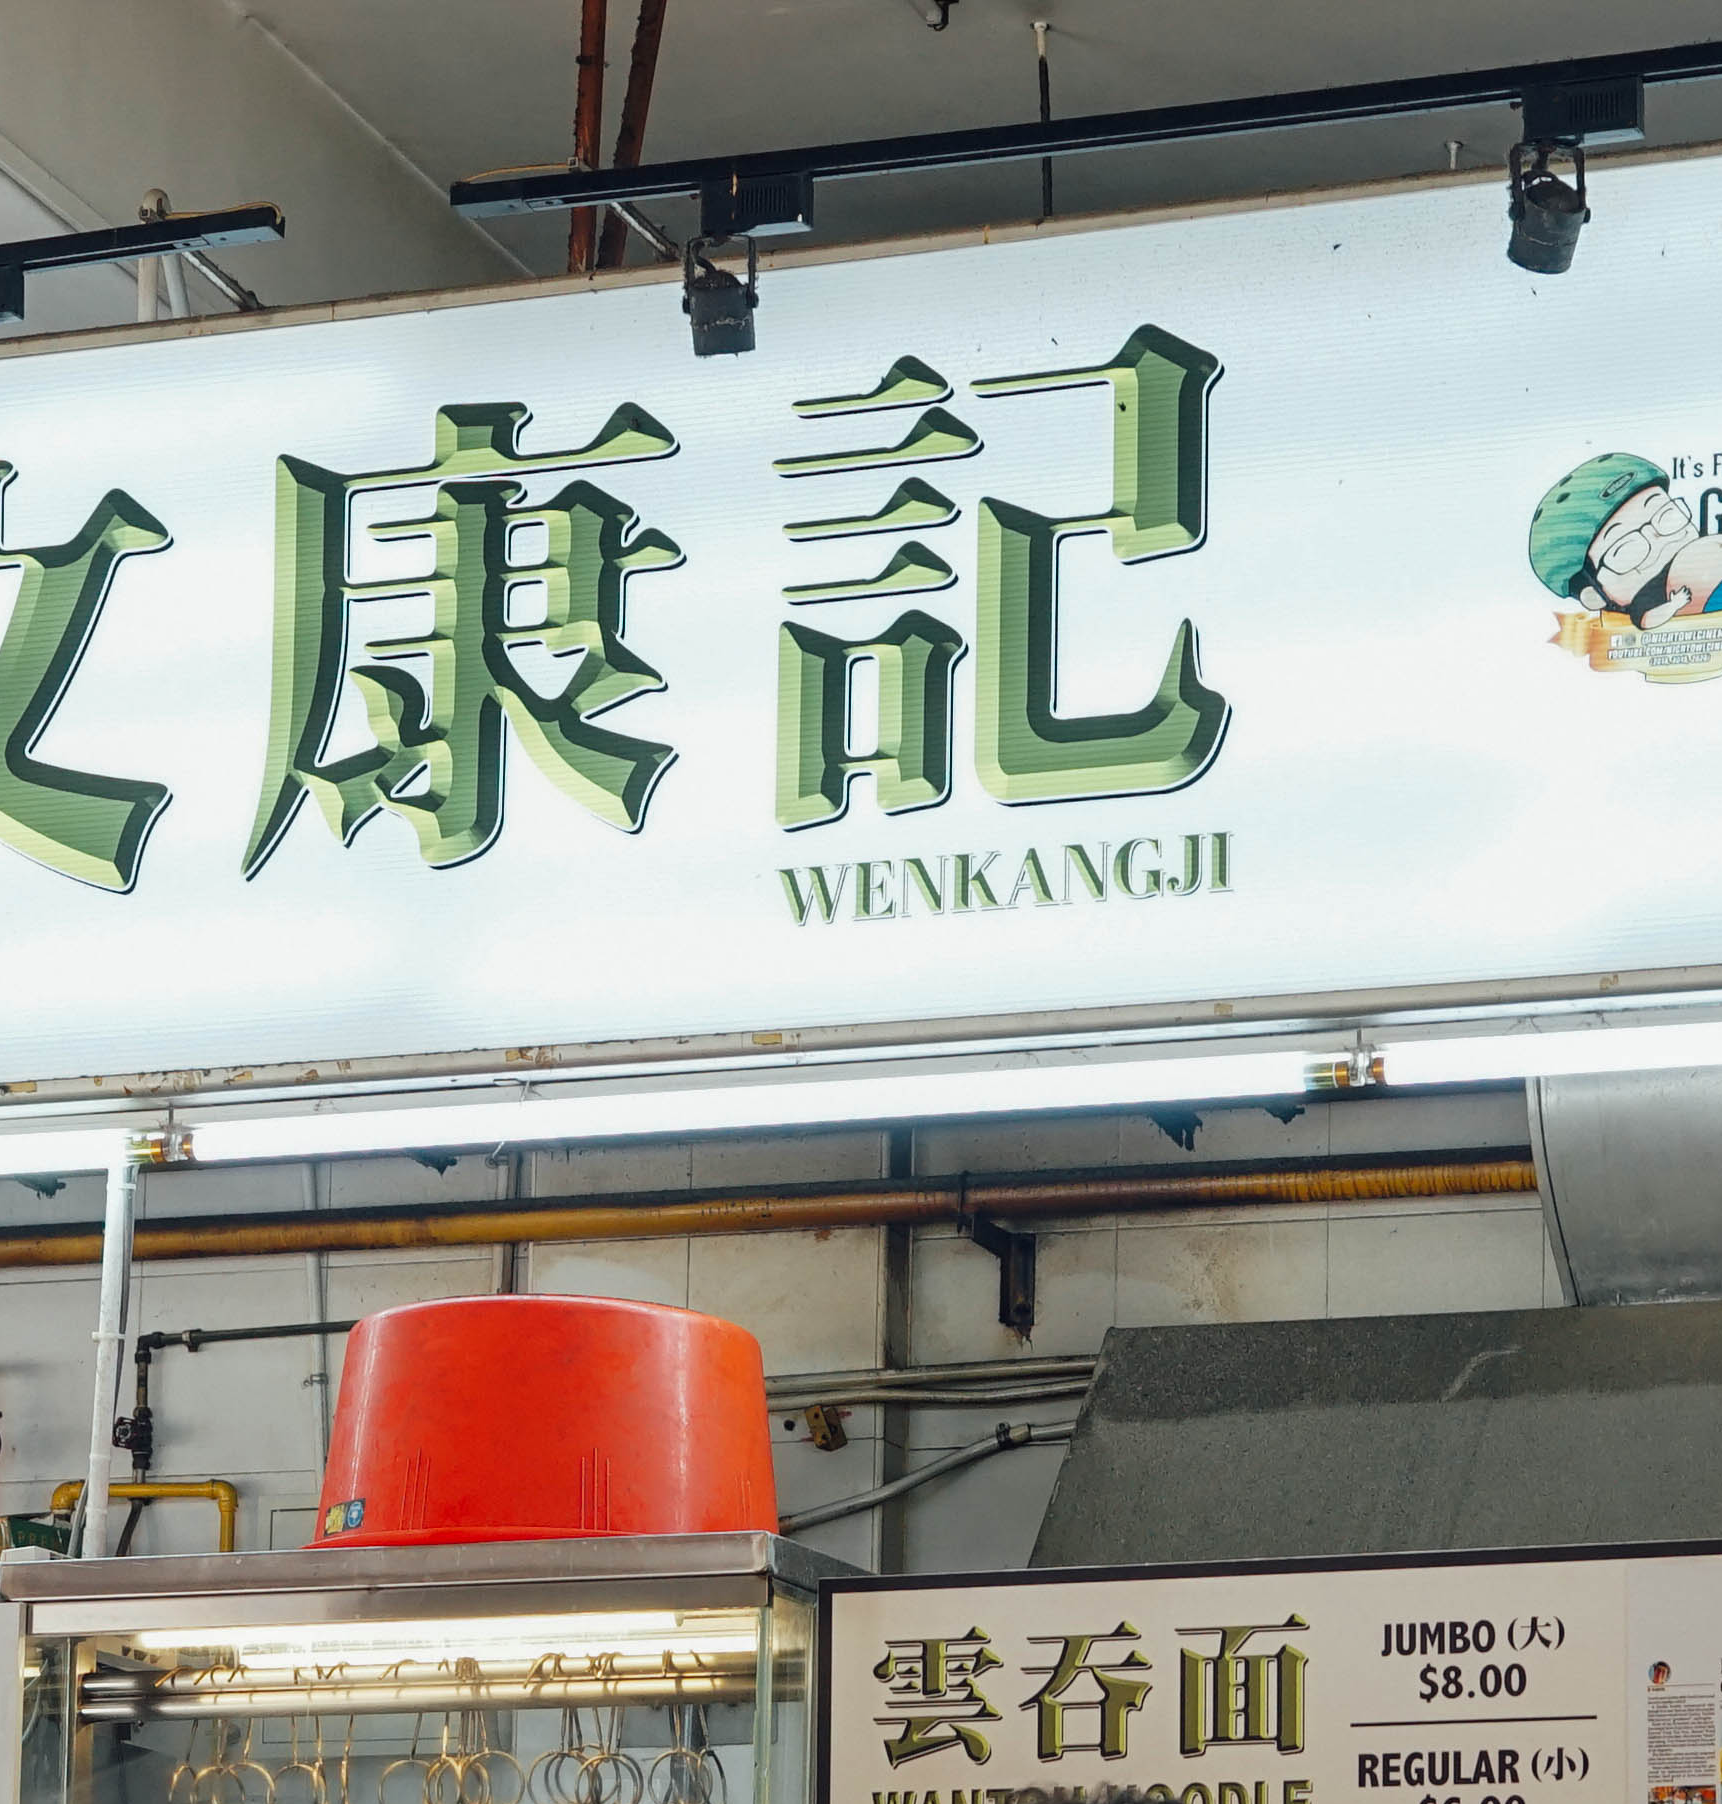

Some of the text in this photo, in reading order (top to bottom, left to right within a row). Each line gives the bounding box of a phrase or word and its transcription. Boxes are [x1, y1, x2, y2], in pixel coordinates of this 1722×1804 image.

[1672, 456, 1703, 480] It's
[779, 831, 1235, 926] WENKANGJI
[1381, 1620, 1496, 1659] JUMBO
[1418, 1662, 1528, 1705] $8.00
[1357, 1749, 1521, 1789] REGULAR
